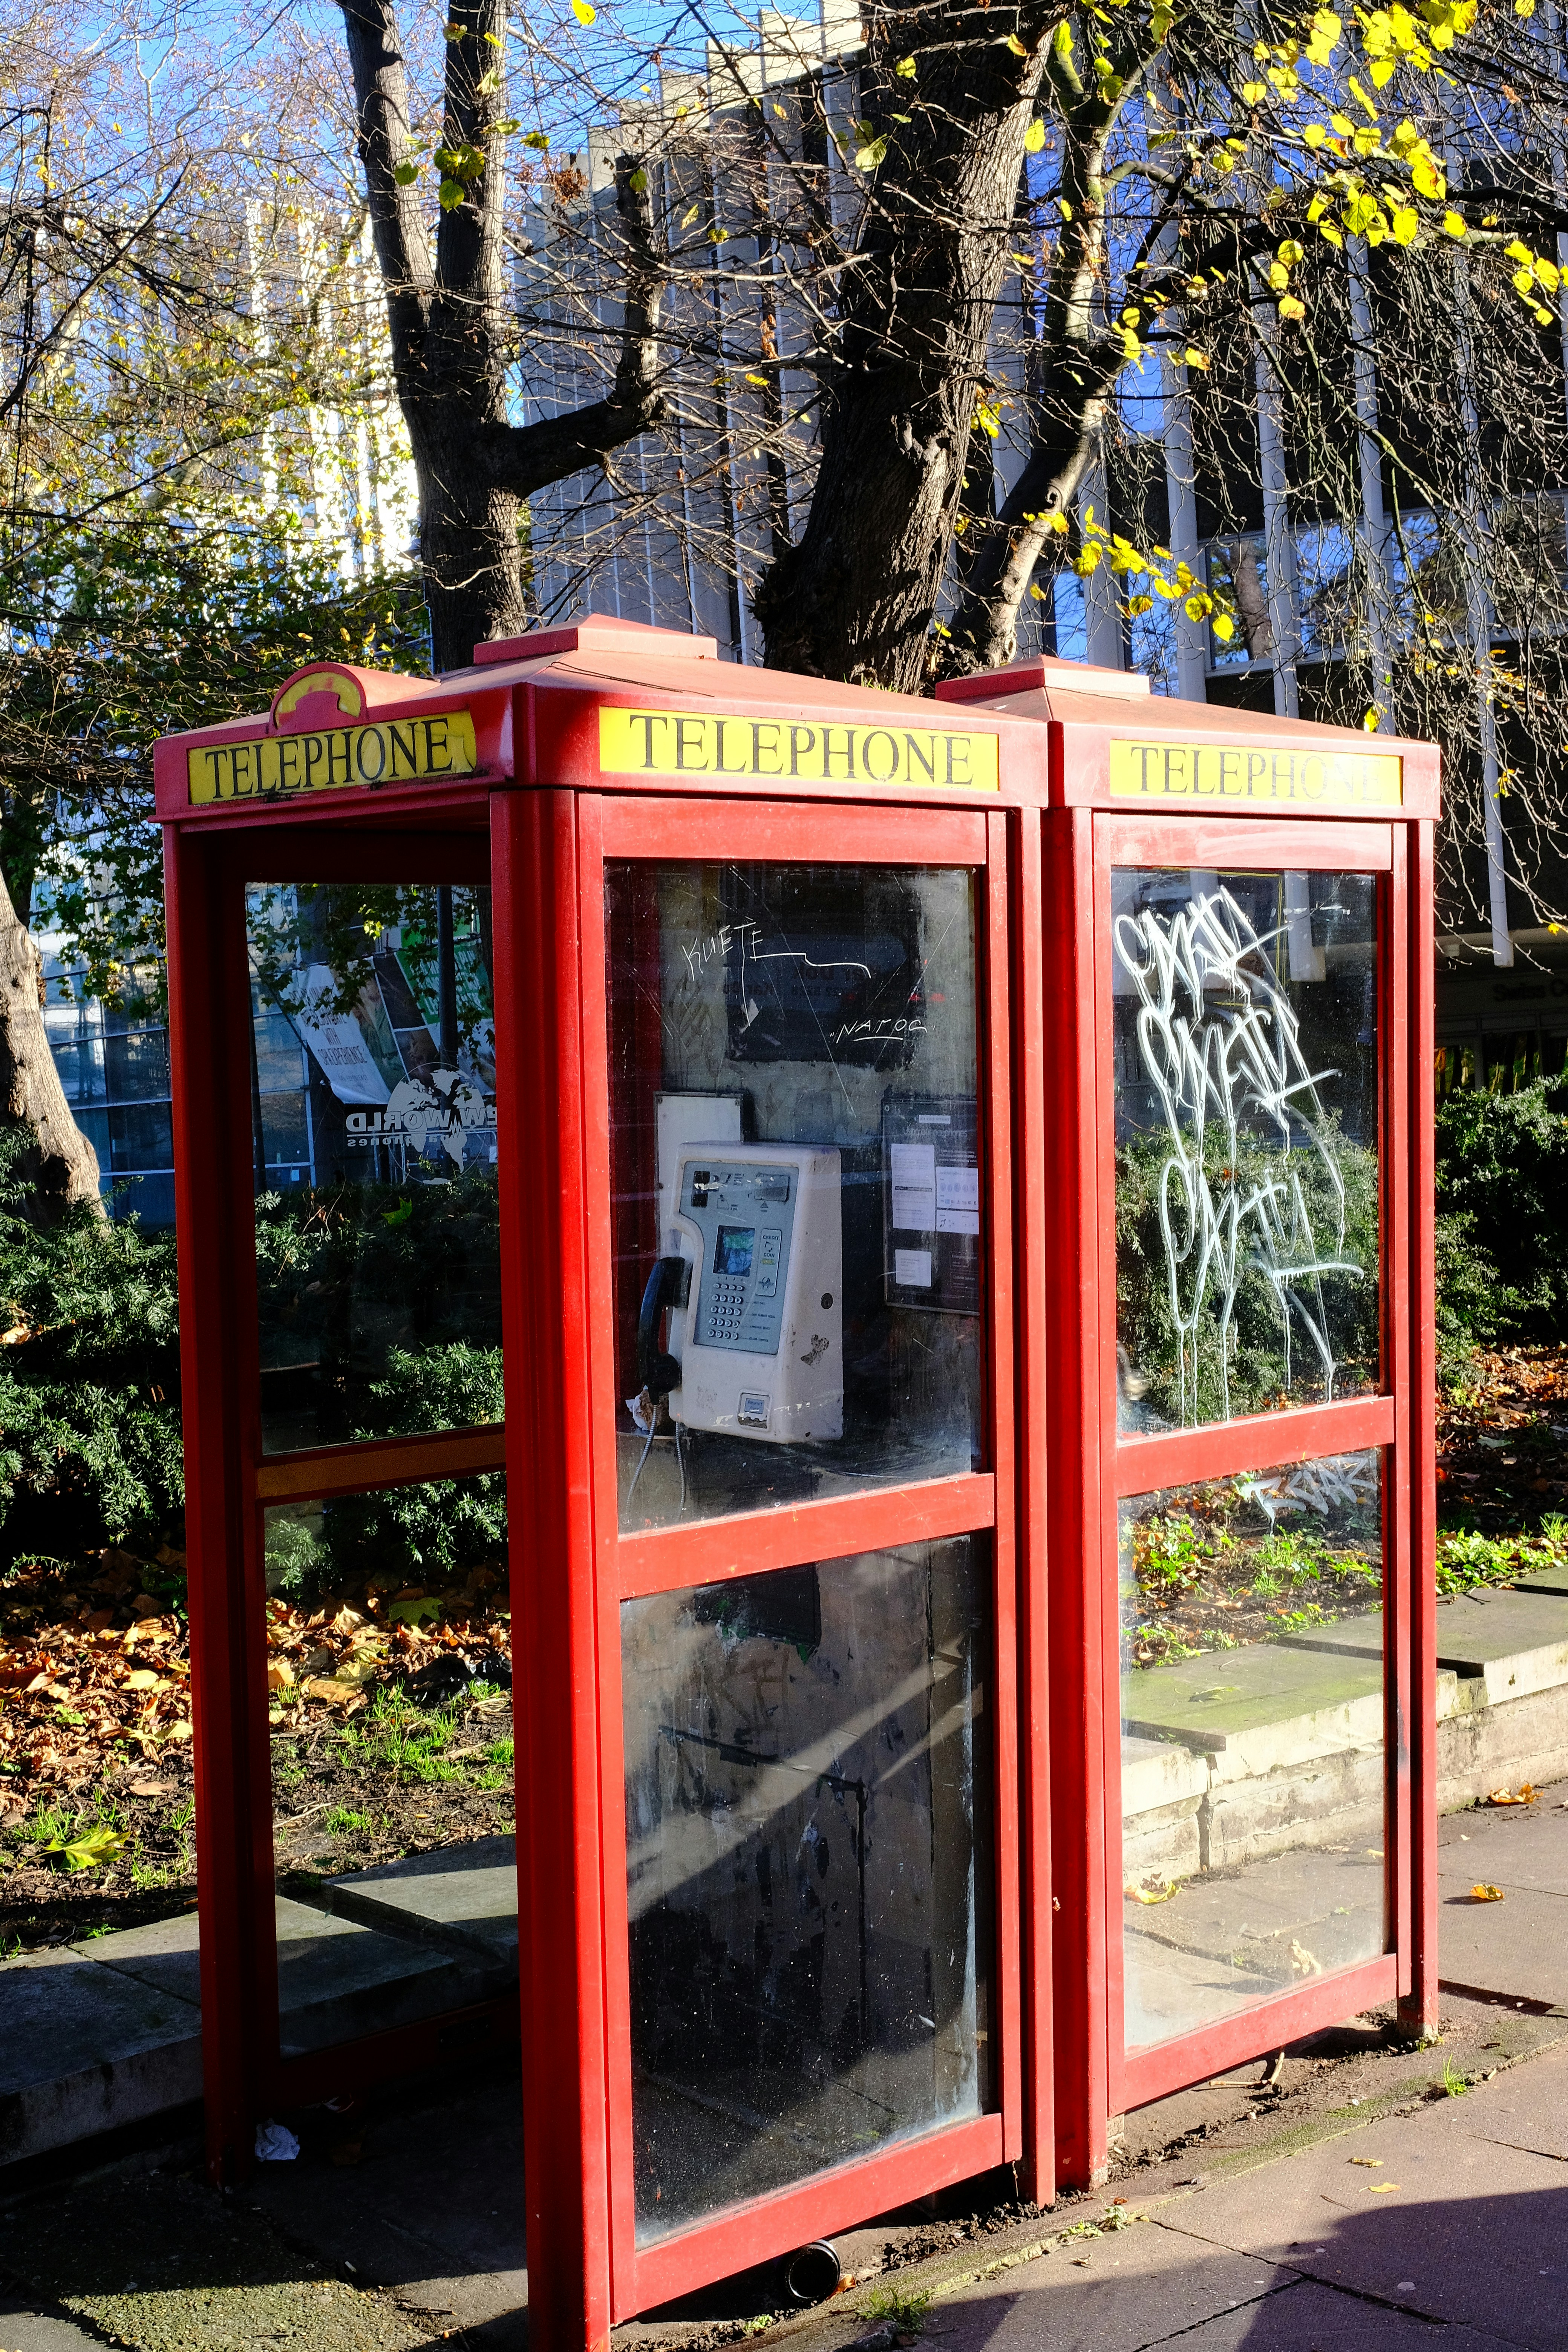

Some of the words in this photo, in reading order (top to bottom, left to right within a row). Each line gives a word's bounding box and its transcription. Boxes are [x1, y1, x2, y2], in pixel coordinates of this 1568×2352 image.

[205, 718, 453, 799] TELEPHONE
[629, 714, 974, 785] TELEPHONE
[1131, 746, 1382, 802] TELEPHONE
